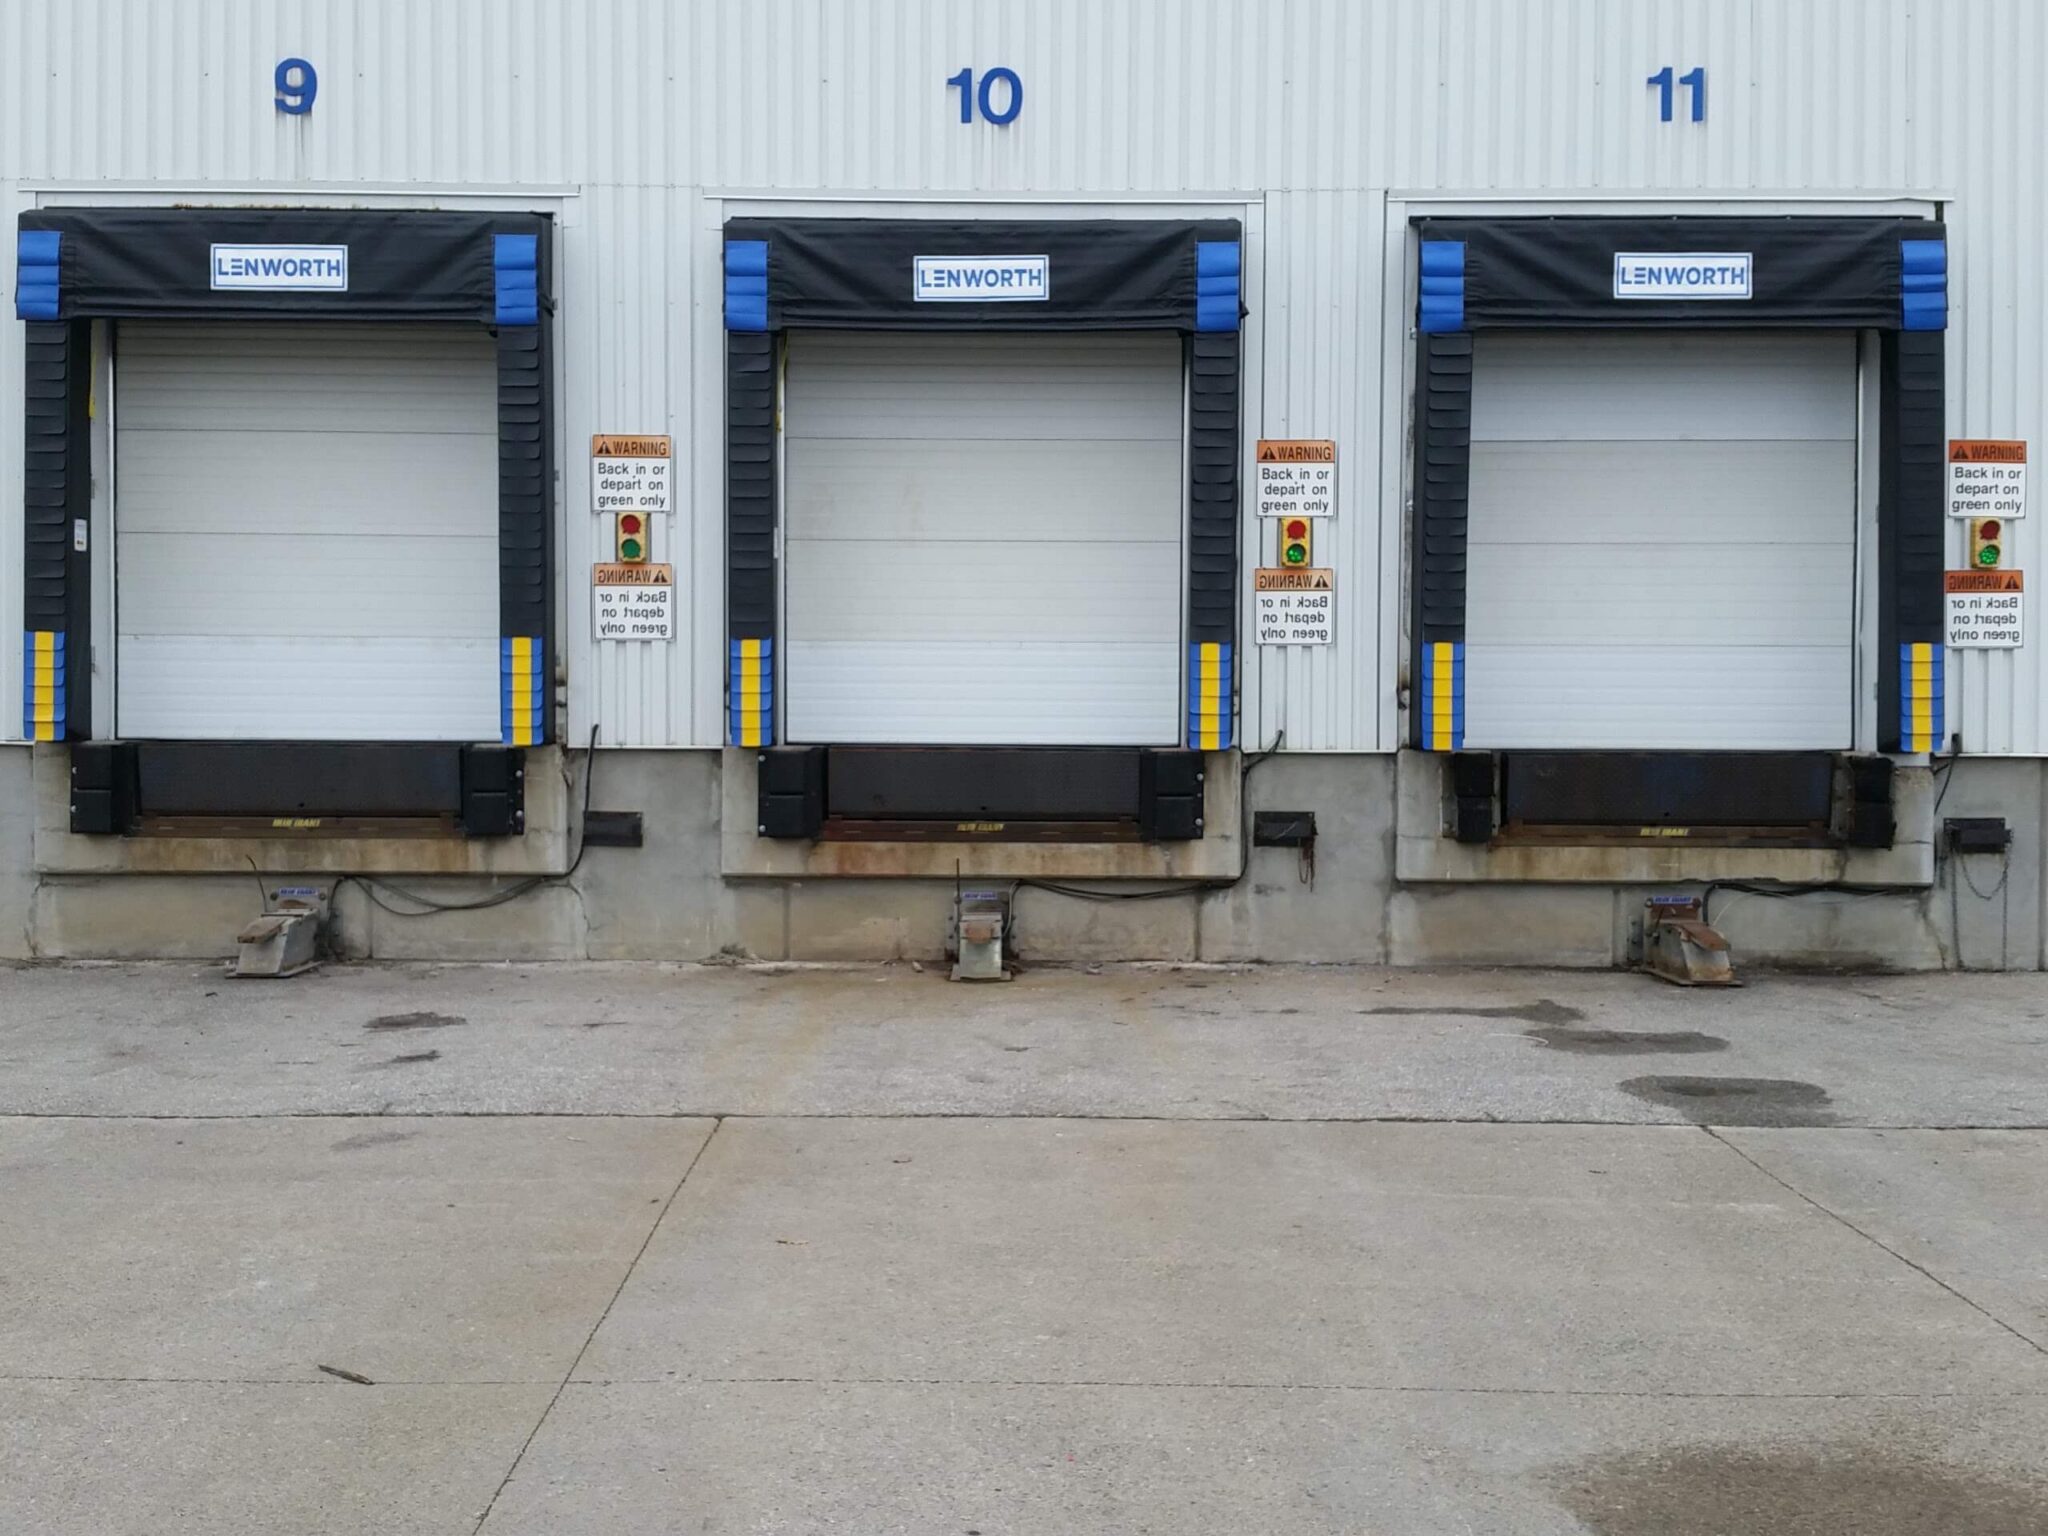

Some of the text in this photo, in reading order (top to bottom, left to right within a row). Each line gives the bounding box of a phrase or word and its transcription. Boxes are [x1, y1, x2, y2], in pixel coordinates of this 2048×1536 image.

[275, 58, 317, 114] 9
[948, 67, 1023, 125] 10
[1648, 67, 1705, 123] 11
[217, 258, 342, 278] LENWORTH
[920, 268, 1042, 289] LENWORTH
[1620, 266, 1745, 286] LENWORTH
[613, 441, 667, 456] WARNING
[1277, 446, 1331, 460] WARNING
[1971, 445, 2024, 460] WARNING
[598, 462, 665, 475] Back in or
[1262, 467, 1329, 480] Back in or
[1954, 466, 2022, 479] Back in or
[600, 478, 664, 492] depart on
[1264, 483, 1327, 497] depart on
[1955, 482, 2019, 497] depart on
[598, 494, 666, 508] green only
[1261, 499, 1329, 513] green only
[1952, 499, 2022, 513] green only
